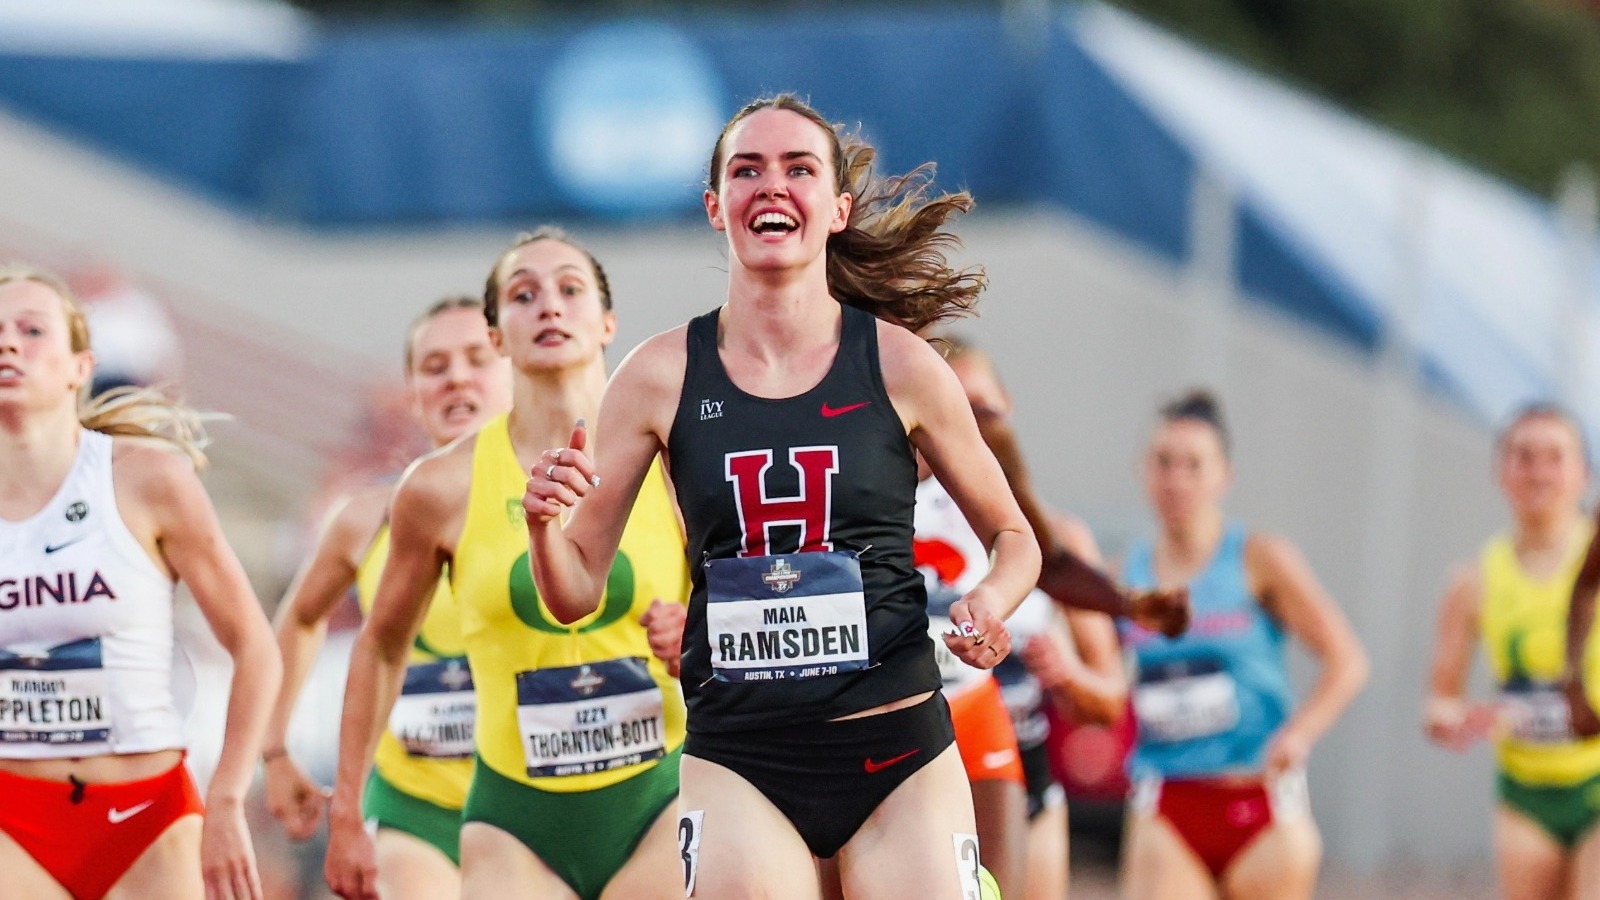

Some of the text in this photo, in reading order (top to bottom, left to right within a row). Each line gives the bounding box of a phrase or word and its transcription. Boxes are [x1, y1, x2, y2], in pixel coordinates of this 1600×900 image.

[700, 411, 723, 420] LEAGUE
[701, 400, 724, 415] IVY
[725, 445, 840, 558] H
[0, 571, 116, 610] GINIA
[763, 606, 807, 625] MAIA
[719, 624, 860, 662] RAMSDEN
[744, 666, 838, 681] AUSTIN, TX JUNE 7-10
[575, 705, 608, 725] IZZY
[529, 717, 659, 759] THORNTON-BOTT
